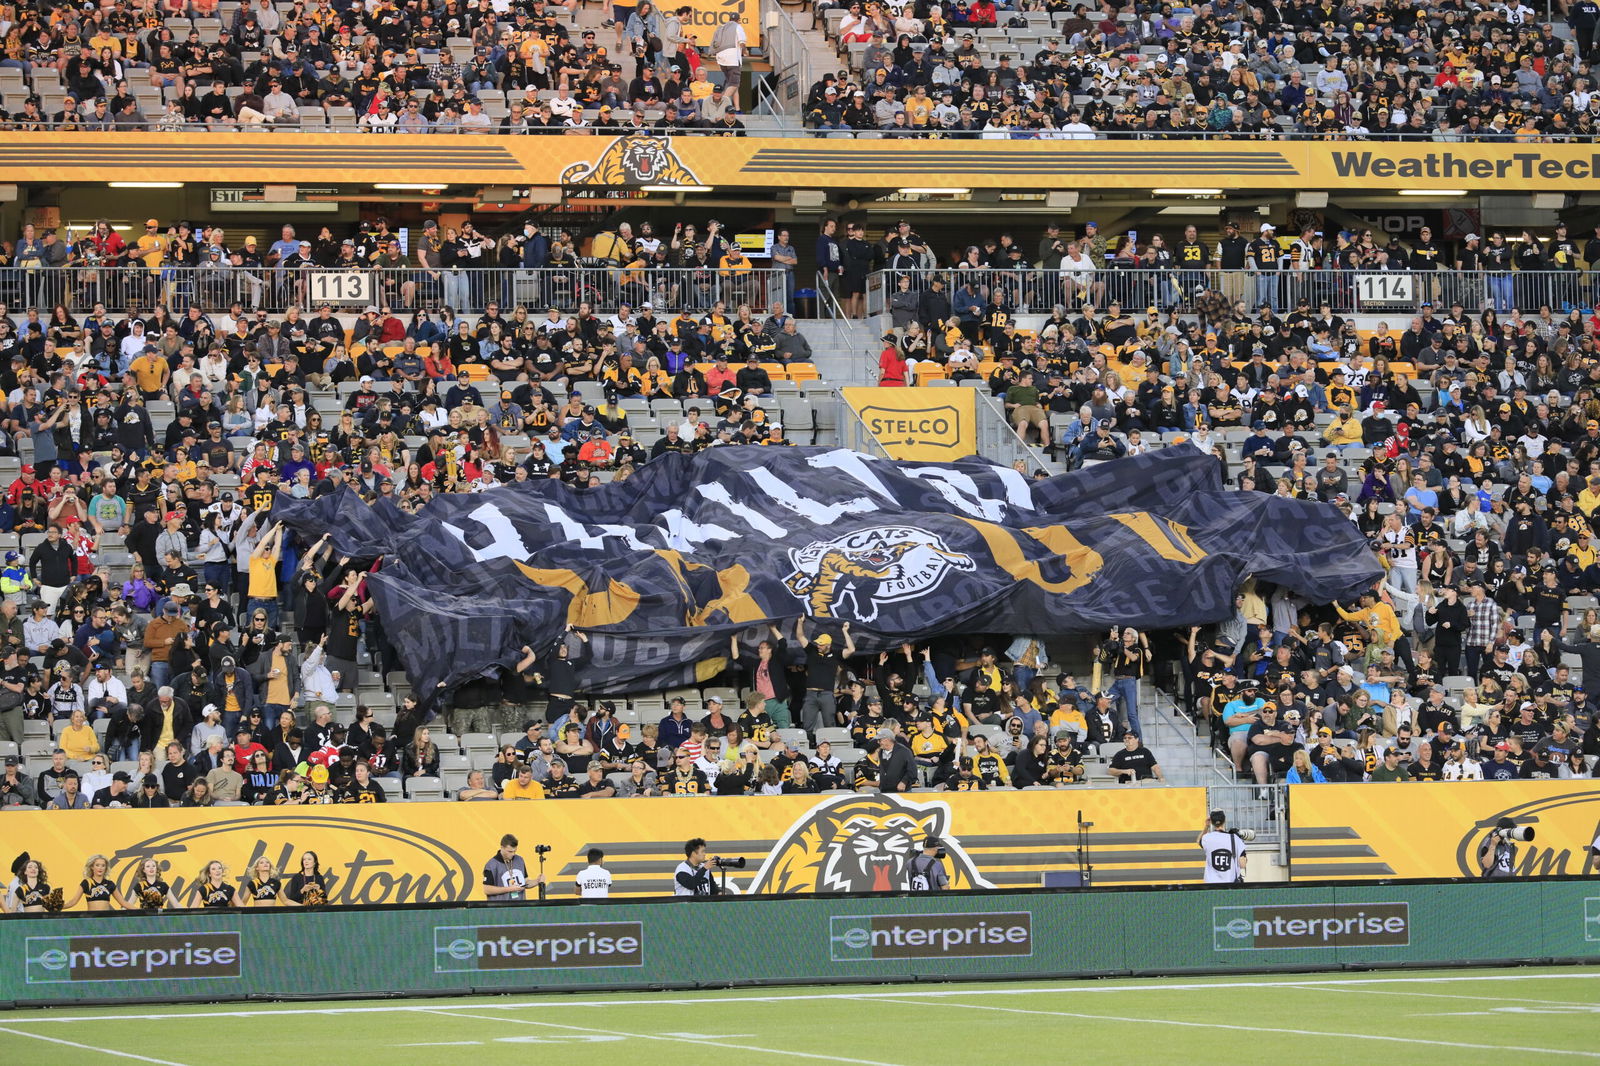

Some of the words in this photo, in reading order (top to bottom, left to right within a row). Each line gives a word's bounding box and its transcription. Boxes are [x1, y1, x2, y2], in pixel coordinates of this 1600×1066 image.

[340, 50, 355, 61] 44
[1507, 112, 1523, 125] 77
[1363, 215, 1425, 233] HOP
[1183, 247, 1201, 262] 33
[1261, 247, 1276, 263] 21
[317, 275, 362, 298] 113
[1364, 277, 1406, 299] 114
[991, 312, 1007, 327] 18
[1347, 373, 1364, 387] 73
[871, 418, 949, 435] STELCO
[253, 493, 273, 513] 68
[847, 528, 914, 549] CATS
[887, 556, 944, 593] FOOTBAL
[1343, 635, 1365, 653] 55
[674, 781, 700, 795] 69
[1214, 855, 1230, 866] CFL
[1225, 911, 1406, 941] enterprise
[843, 921, 1028, 951] enterprise
[447, 930, 639, 962] enterprise
[40, 942, 237, 971] enterprise
